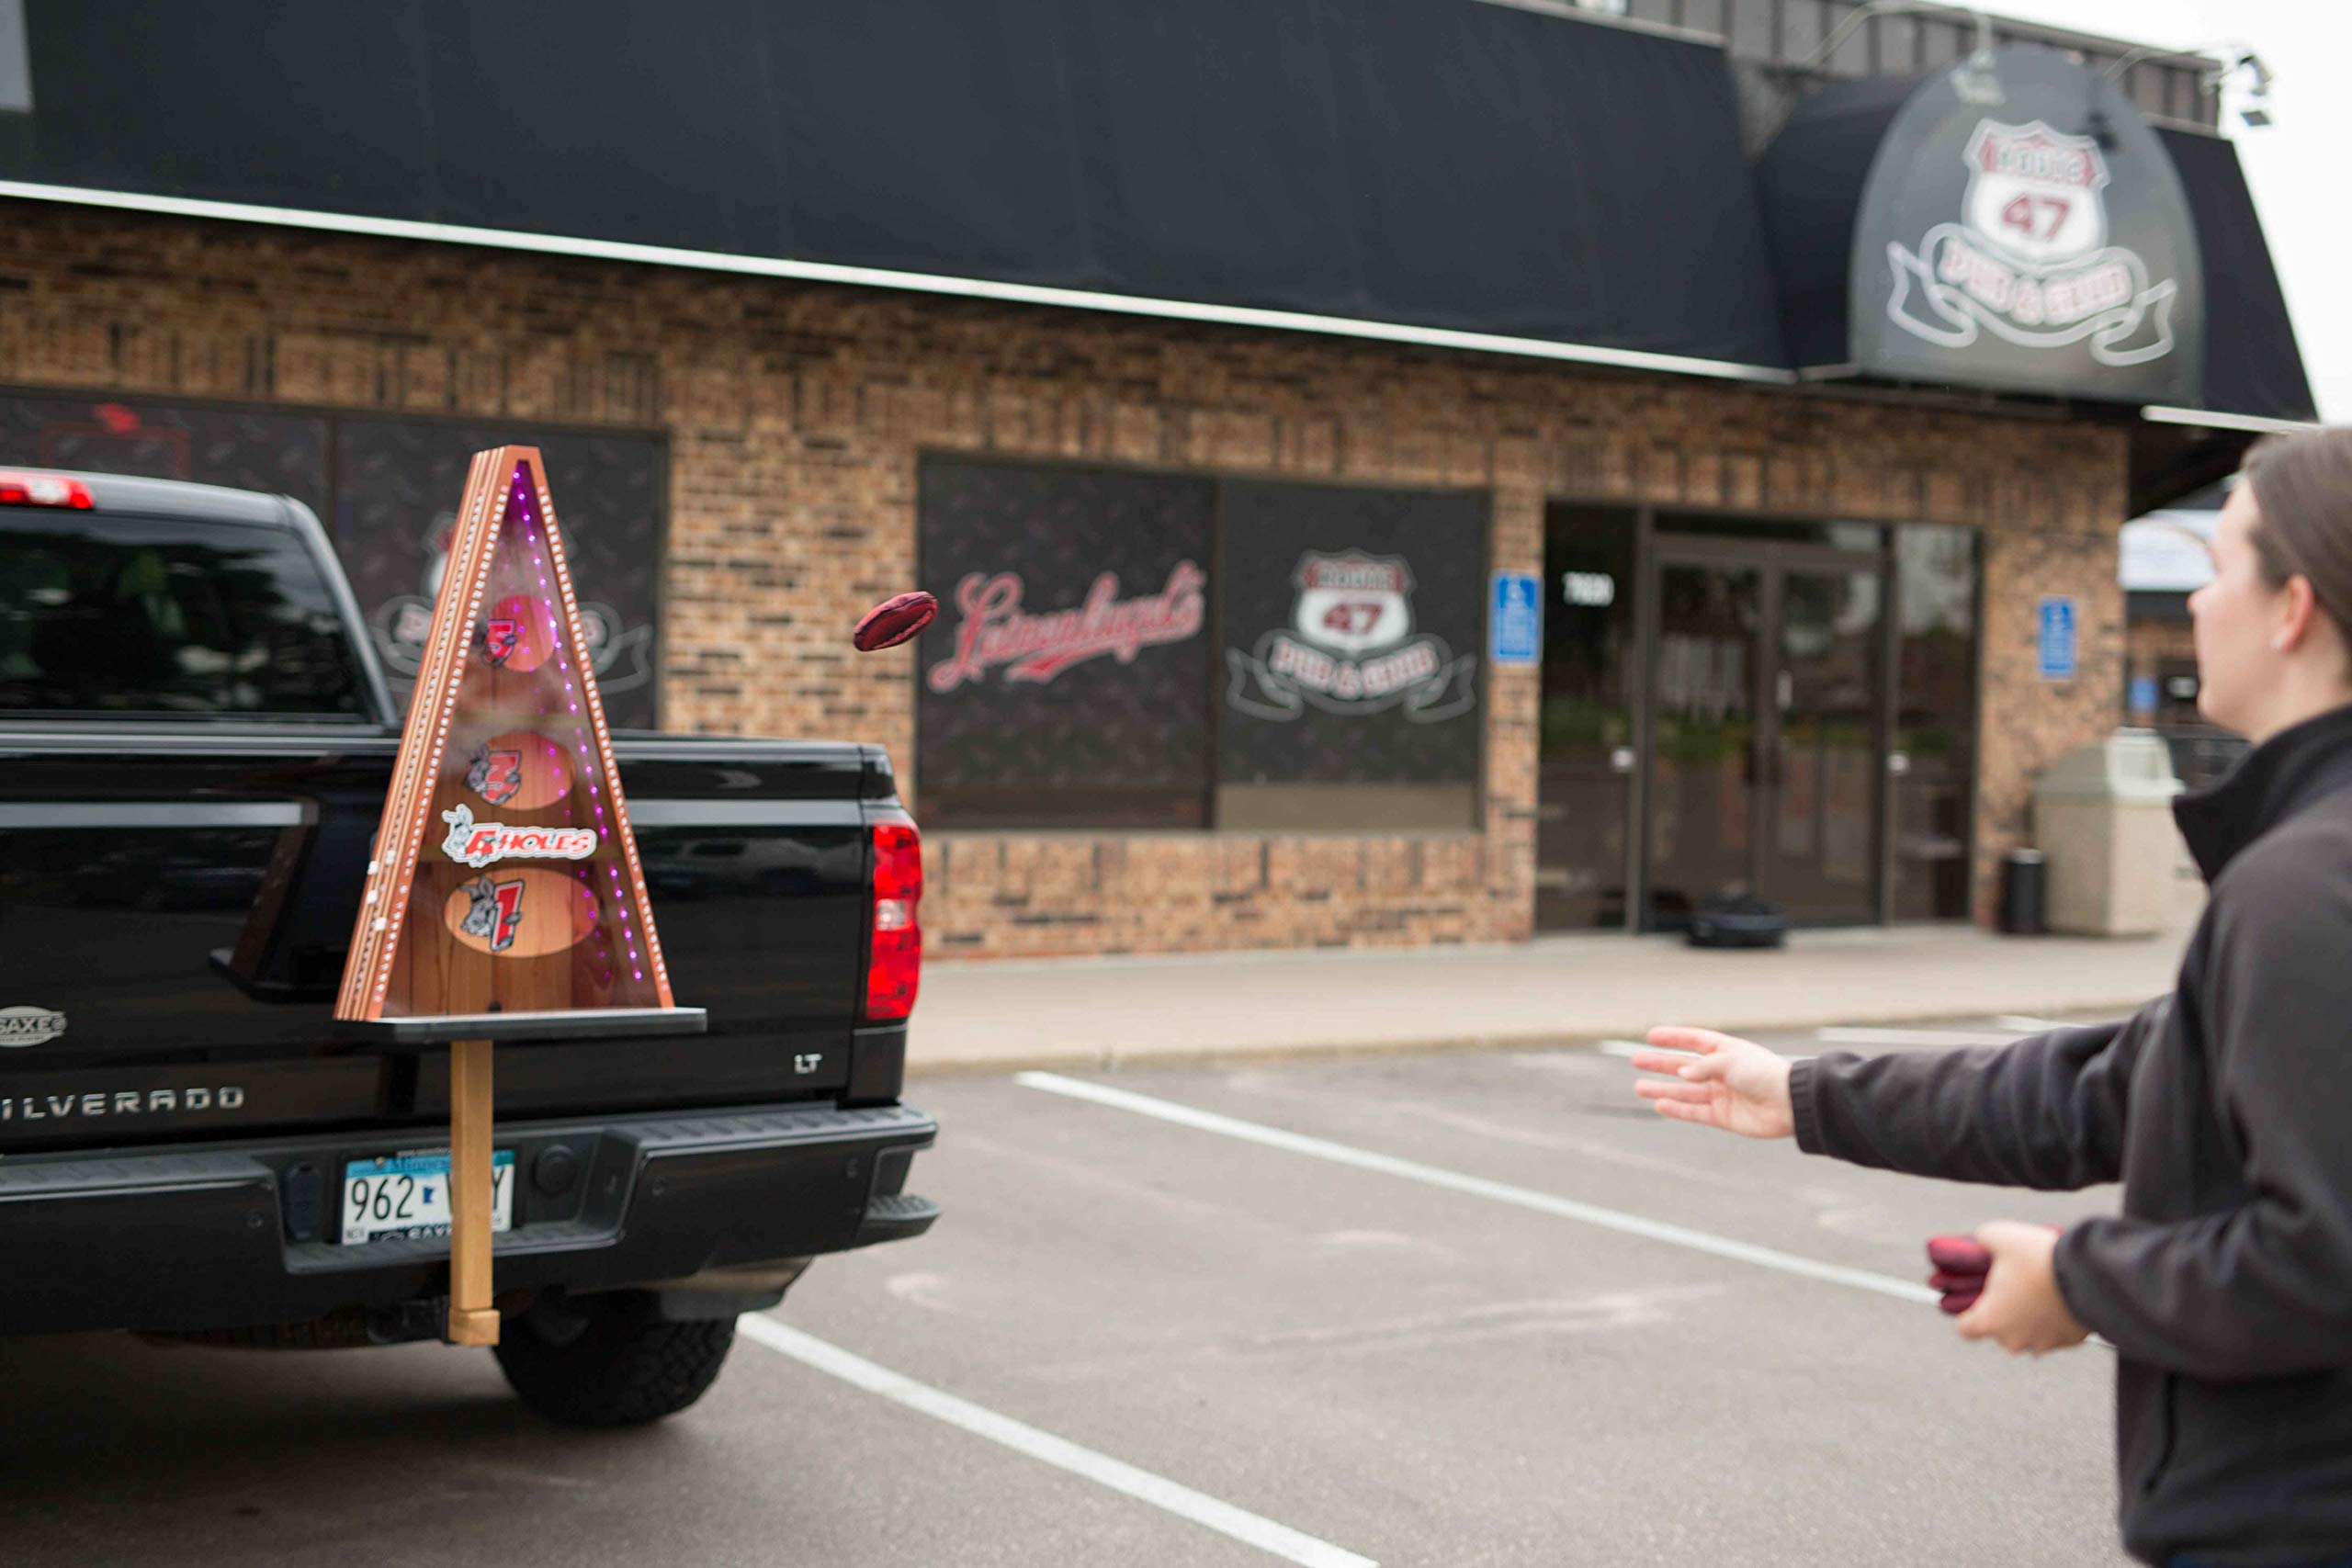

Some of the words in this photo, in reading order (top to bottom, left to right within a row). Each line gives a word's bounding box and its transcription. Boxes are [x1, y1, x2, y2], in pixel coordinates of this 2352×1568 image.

[2003, 193, 2071, 243] 47
[1322, 602, 1383, 634] 47
[491, 880, 525, 951] 1
[794, 1054, 822, 1074] LT
[1, 1087, 245, 1120] ILVERADO
[351, 1175, 414, 1222] 962
